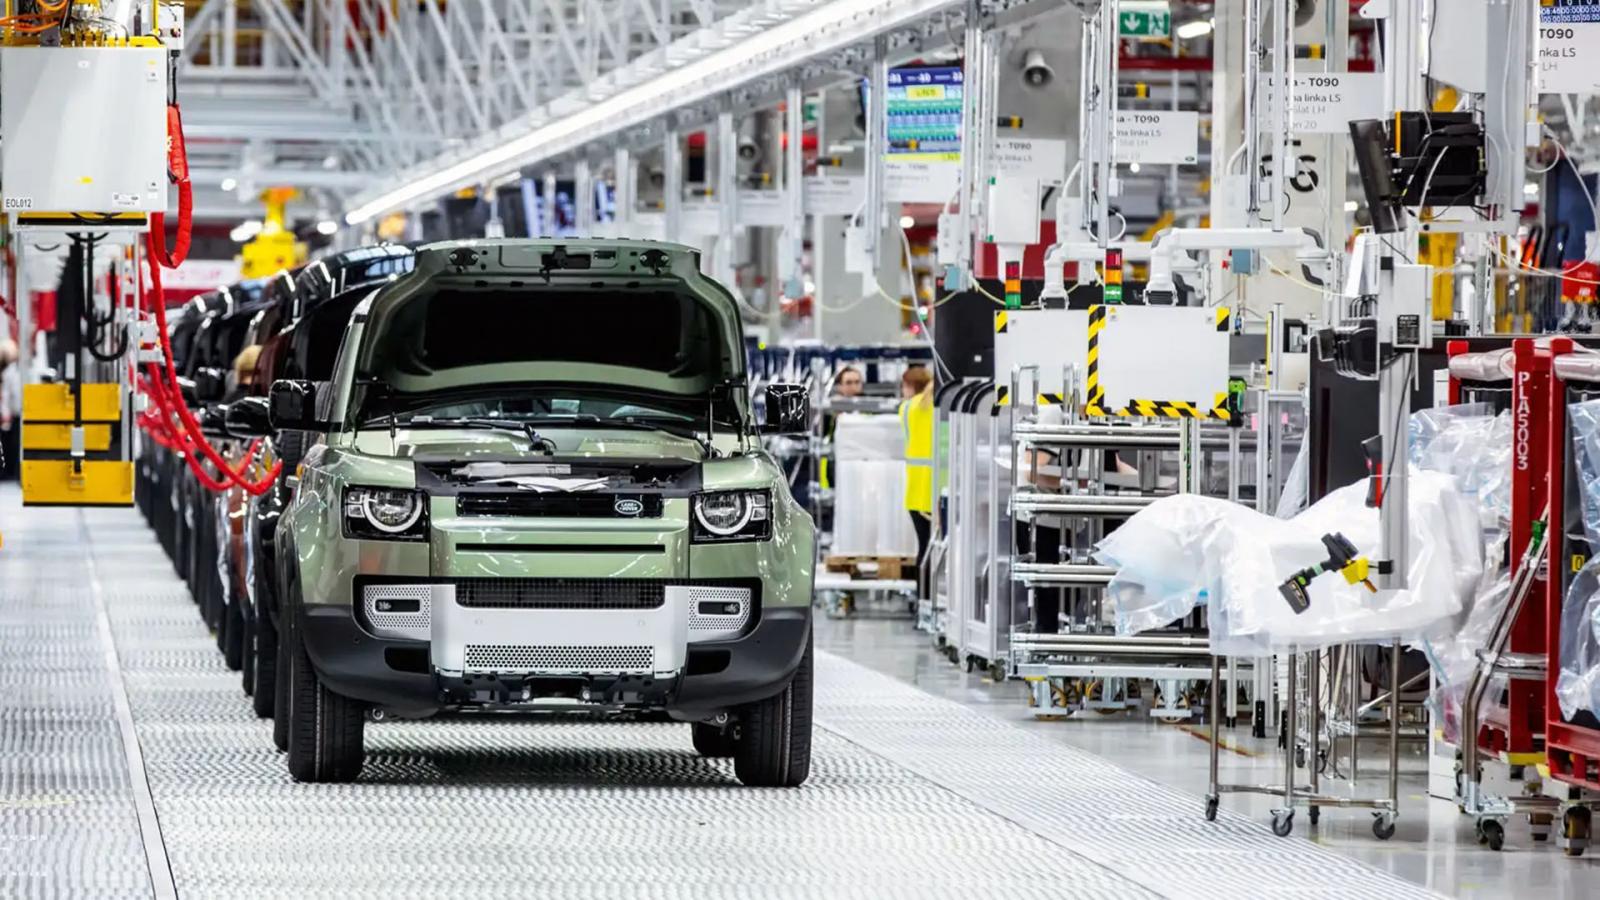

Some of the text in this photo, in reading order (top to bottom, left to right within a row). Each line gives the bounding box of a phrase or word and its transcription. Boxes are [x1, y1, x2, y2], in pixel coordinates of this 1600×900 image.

[1539, 28, 1574, 39] T090
[1539, 47, 1576, 57] nka LS
[1309, 77, 1339, 87] T090
[1304, 93, 1327, 102] linka
[1329, 94, 1341, 102] LS
[1134, 115, 1160, 123] T090
[5, 198, 32, 208] EOL012
